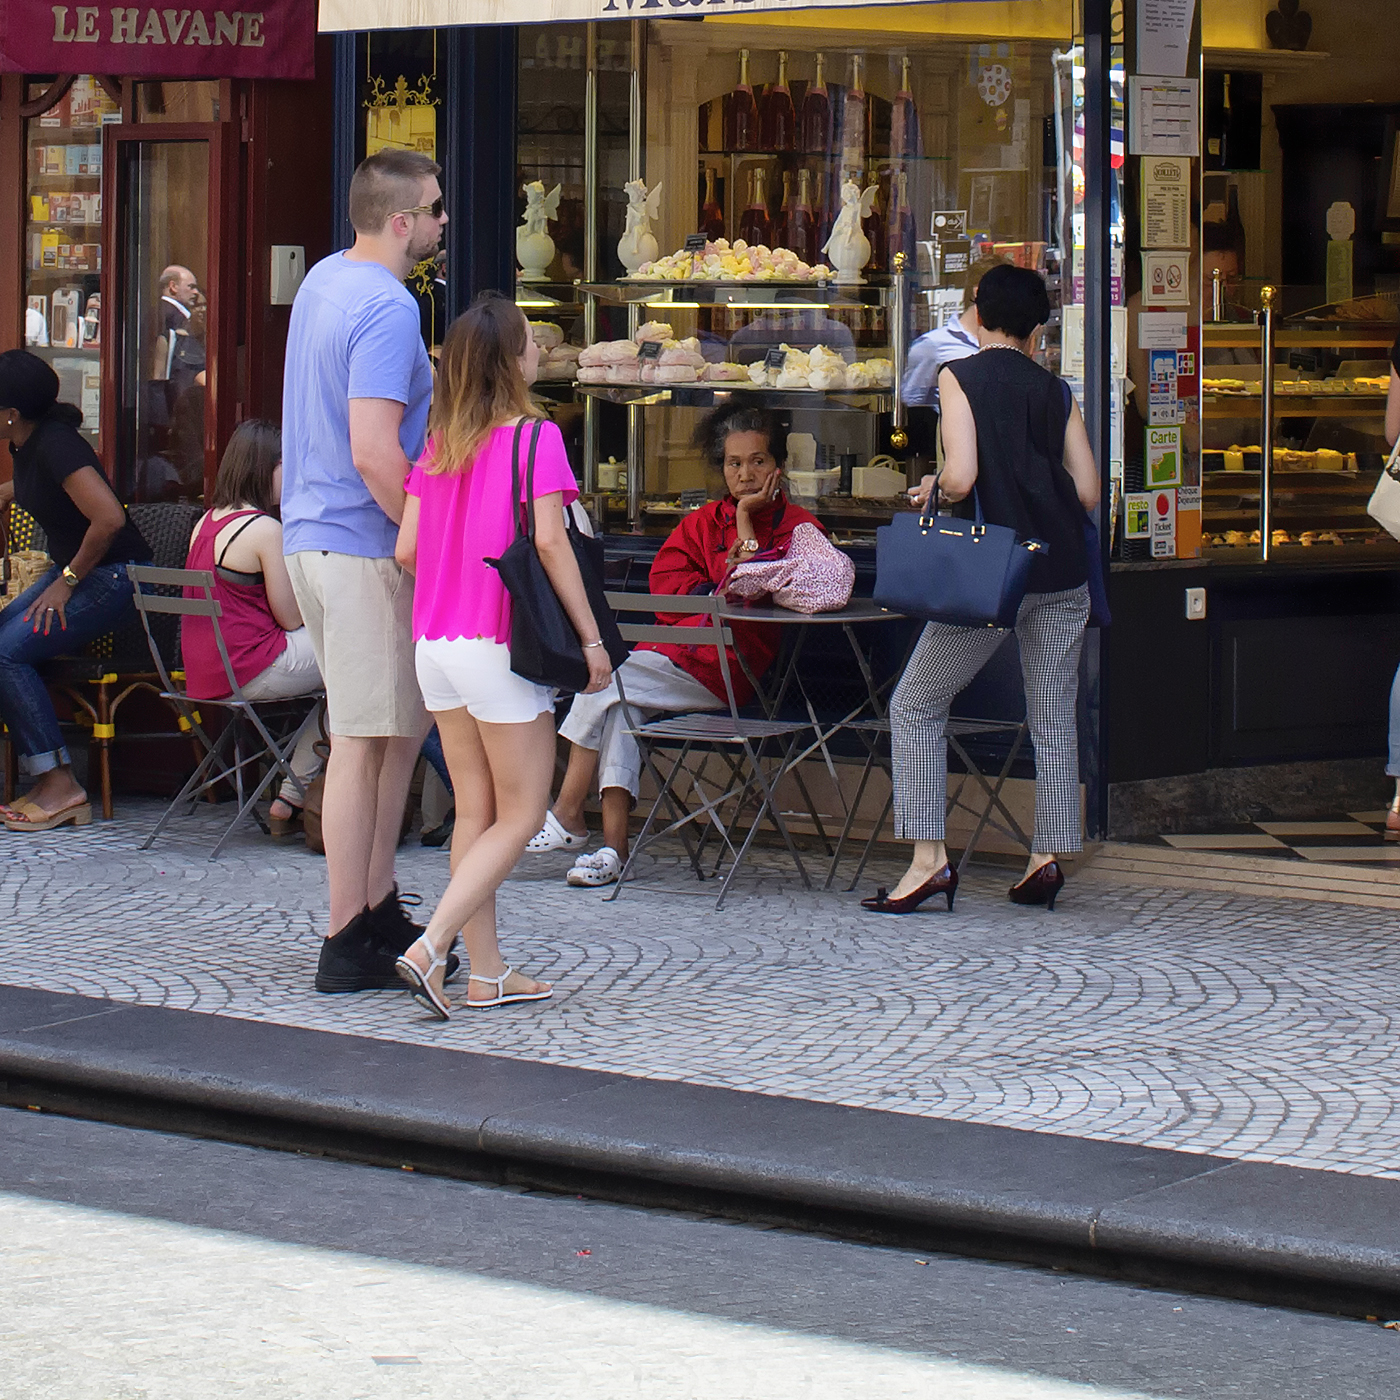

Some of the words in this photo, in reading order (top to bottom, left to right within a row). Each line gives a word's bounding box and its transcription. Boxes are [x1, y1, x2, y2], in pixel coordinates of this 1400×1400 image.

[51, 5, 99, 44] LE
[110, 7, 265, 48] HAVANE
[1150, 431, 1177, 444] Carte
[1128, 501, 1149, 510] resto
[1154, 523, 1171, 532] Ticket
